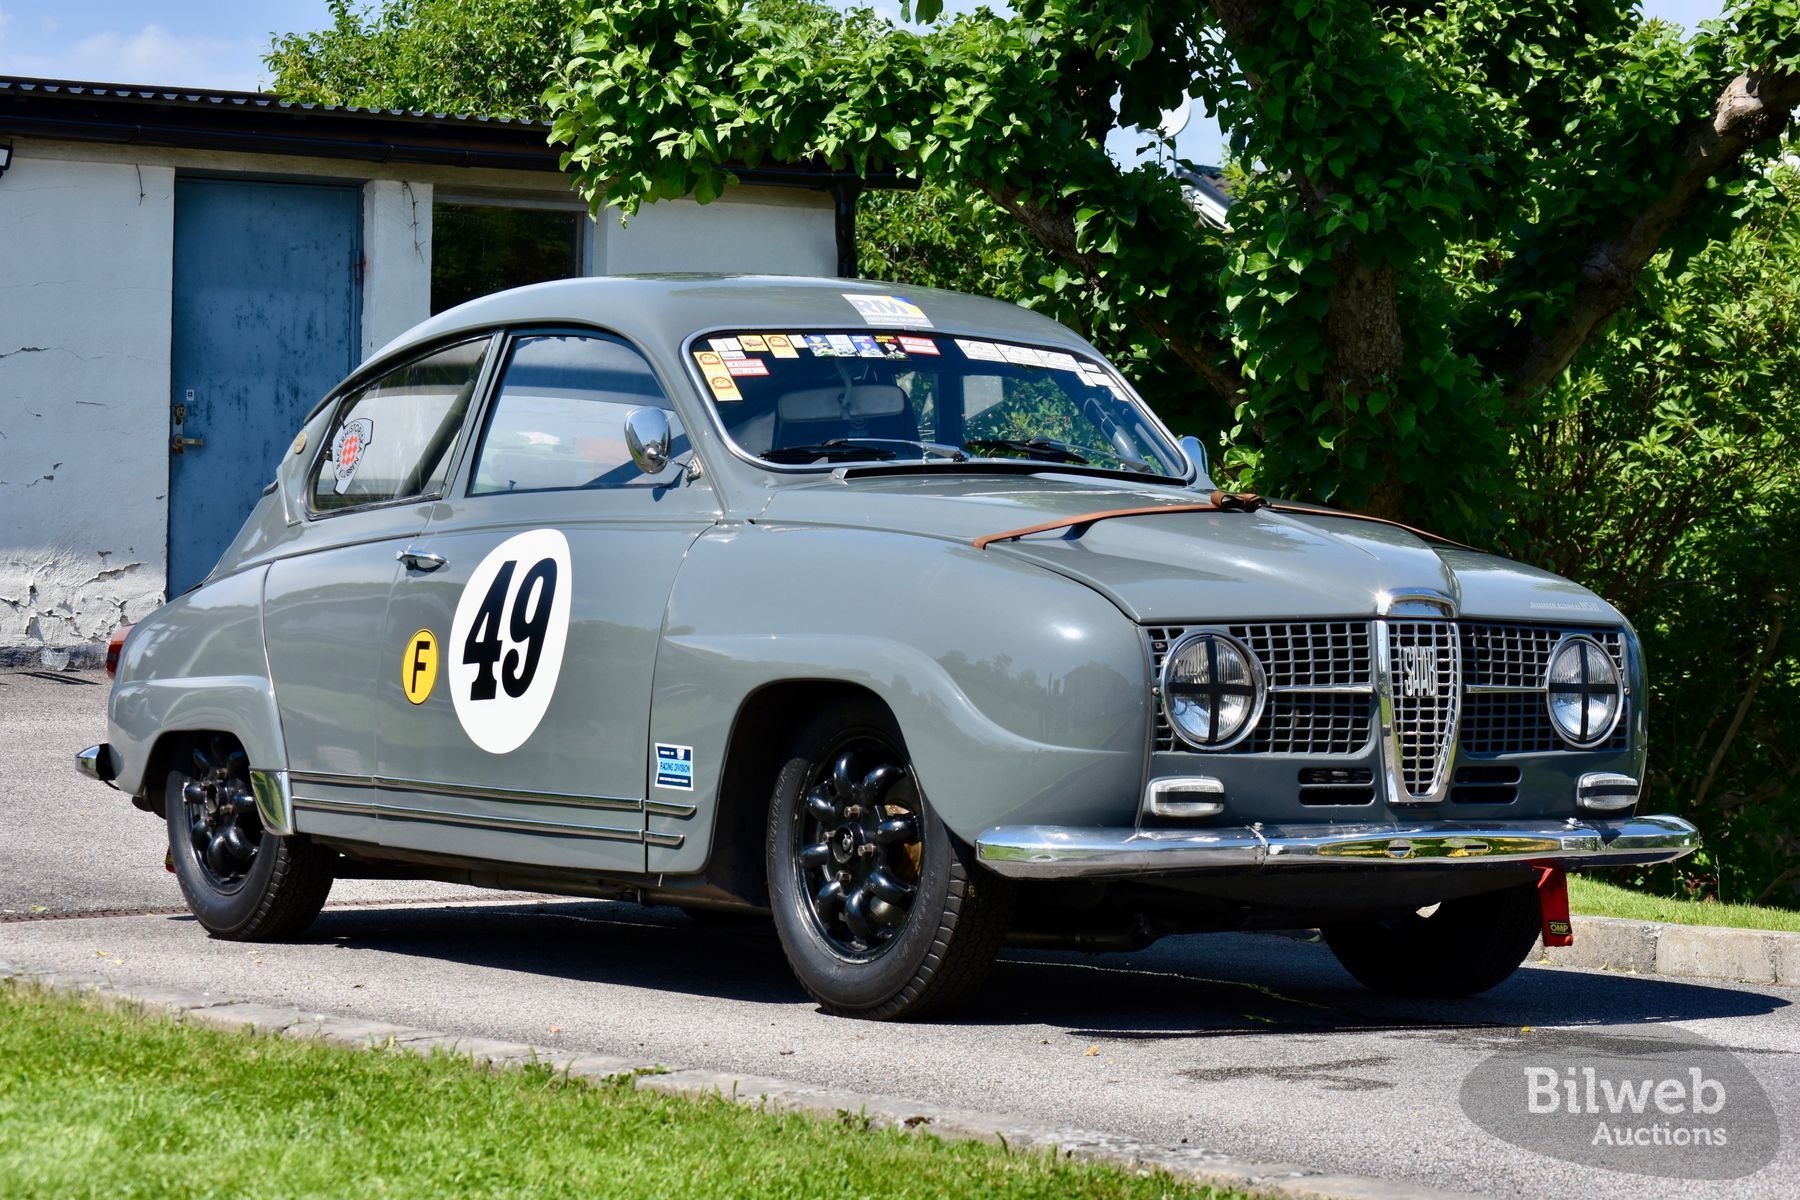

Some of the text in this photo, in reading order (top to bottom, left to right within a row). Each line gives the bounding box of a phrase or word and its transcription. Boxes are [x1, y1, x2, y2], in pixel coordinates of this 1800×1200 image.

[462, 557, 558, 701] 49
[411, 641, 430, 694] F
[1402, 646, 1437, 697] SAAB
[1550, 924, 1568, 932] OMP
